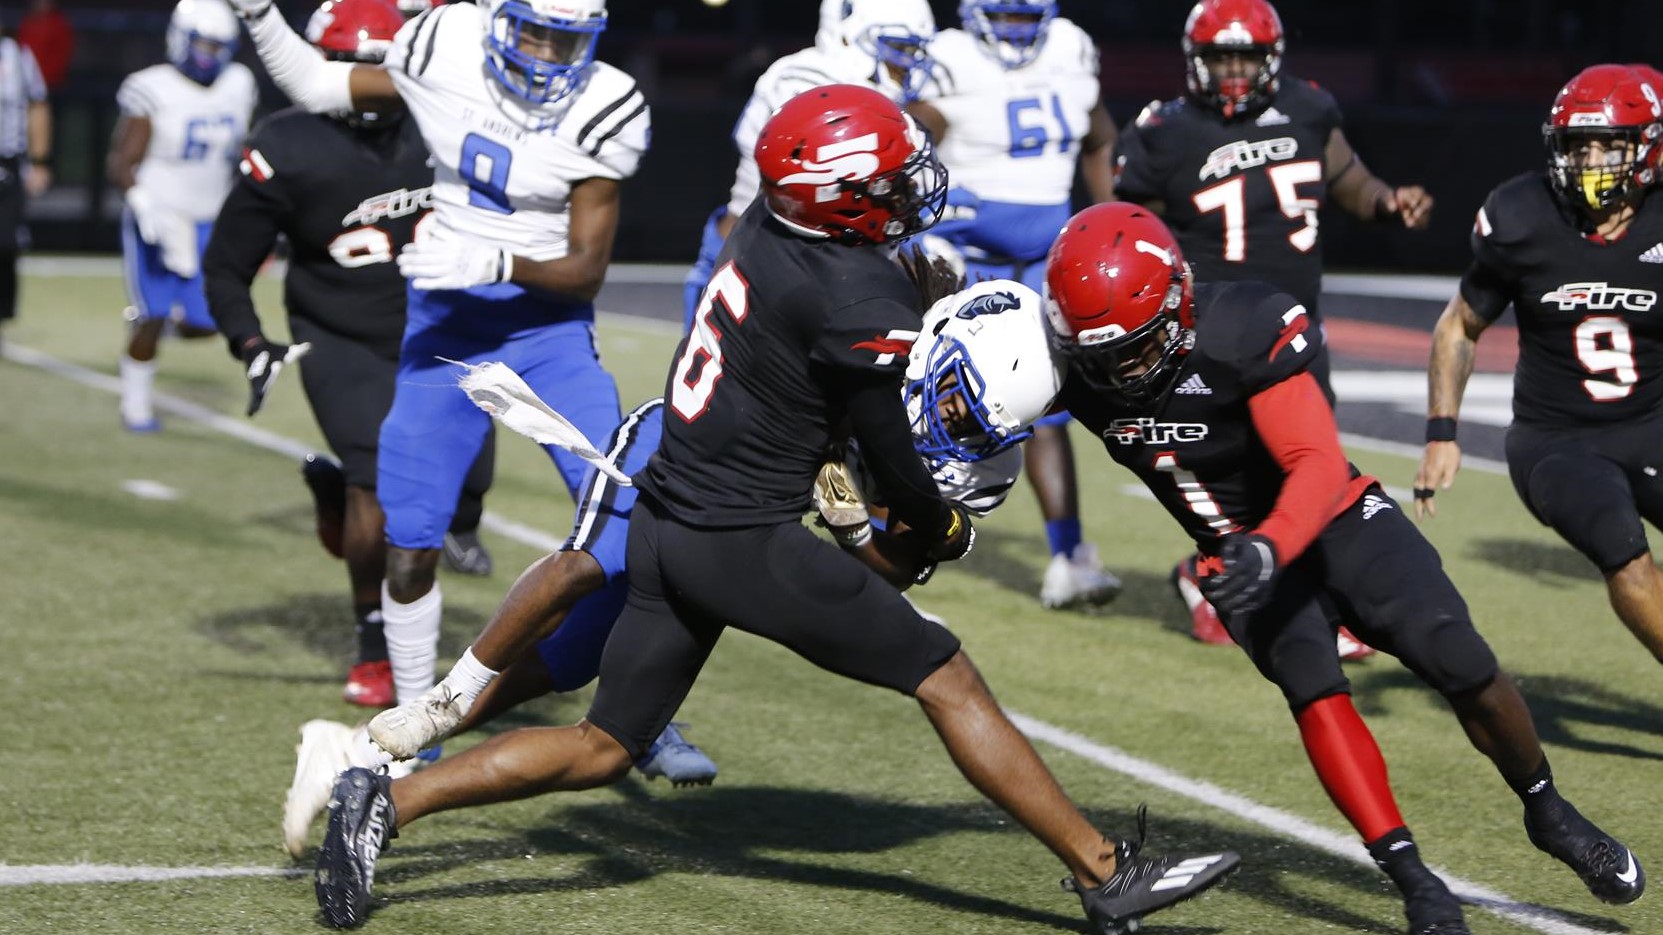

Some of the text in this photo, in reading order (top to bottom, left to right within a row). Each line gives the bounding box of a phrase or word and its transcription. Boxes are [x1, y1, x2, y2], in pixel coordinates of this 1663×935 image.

[1007, 93, 1072, 158] 61
[1190, 159, 1323, 263] 75
[1541, 282, 1657, 312] Fire
[671, 259, 750, 424] 6
[1573, 315, 1639, 402] 9
[1103, 417, 1208, 444] Fire
